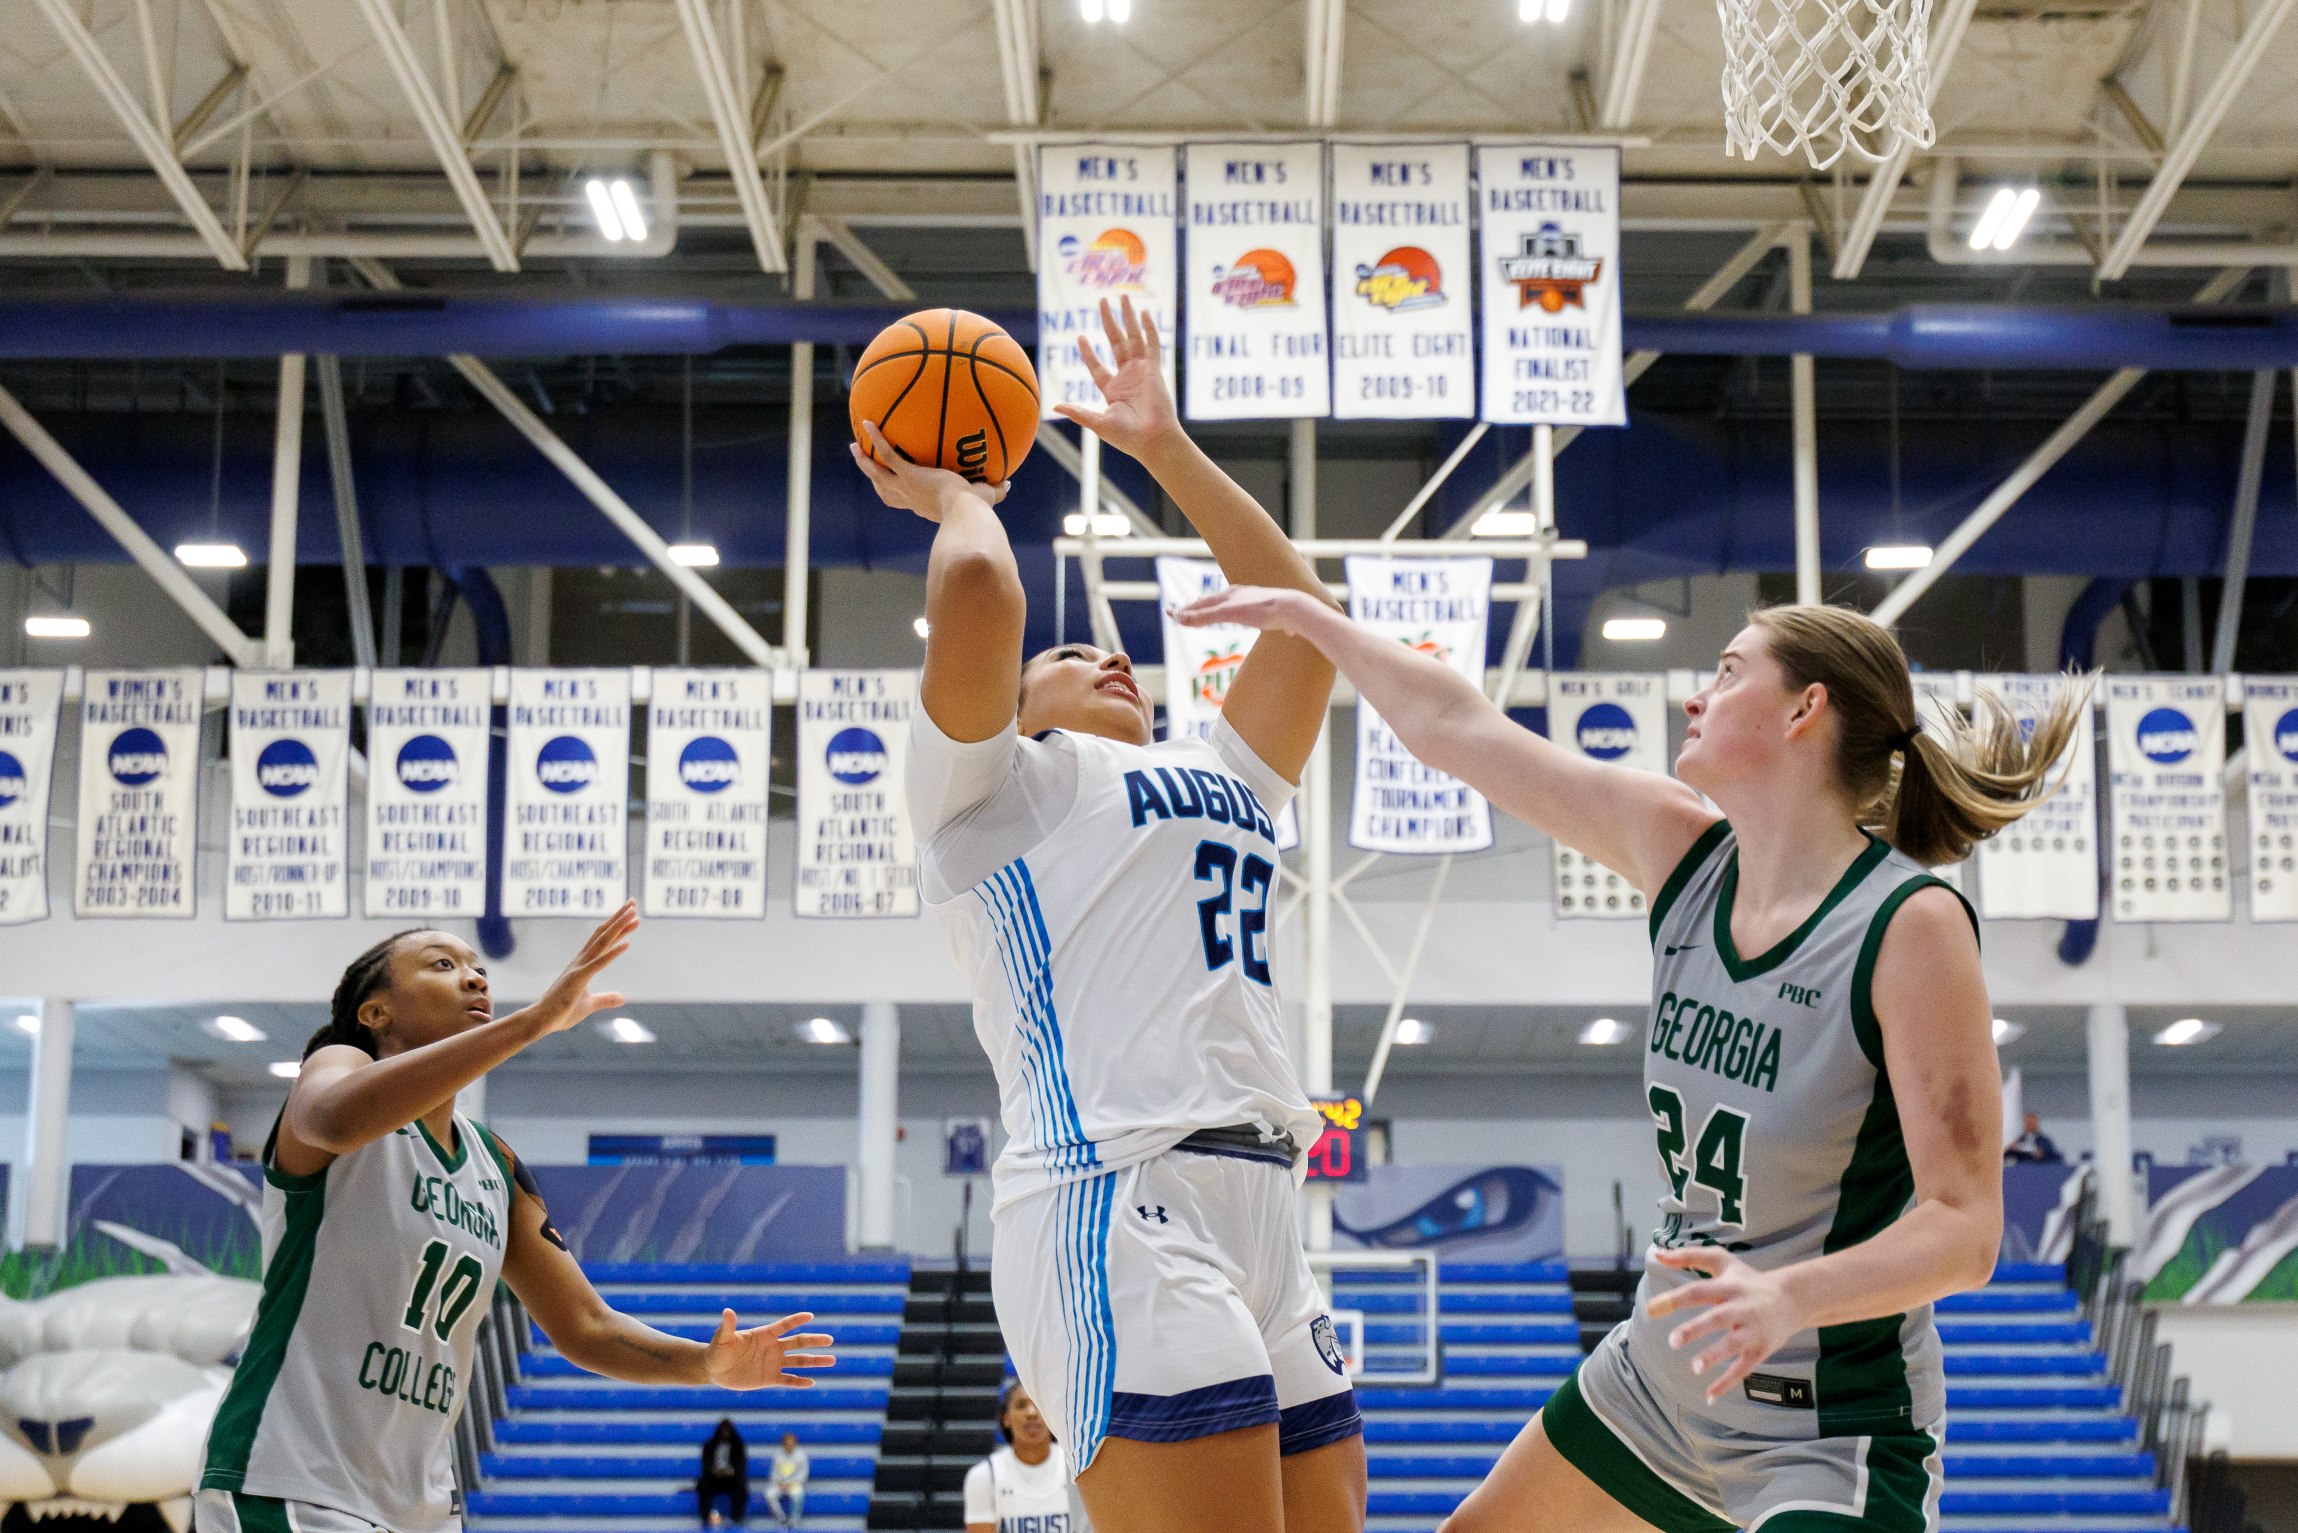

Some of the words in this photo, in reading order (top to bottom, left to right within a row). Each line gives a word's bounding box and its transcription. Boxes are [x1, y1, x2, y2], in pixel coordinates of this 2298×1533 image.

[1079, 157, 1138, 180] MEN'S
[1225, 161, 1287, 184] MEN'S
[1370, 162, 1433, 186] MEN'S
[1521, 158, 1577, 180] MEN'S
[1044, 193, 1174, 217] BASKETBALL
[1491, 190, 1606, 212] BASKETBALL
[1194, 202, 1317, 225] BASKETBALL
[1340, 203, 1463, 226] BASKETBALL
[1194, 335, 1252, 358] FINAL
[1271, 333, 1325, 357] FOUR
[1339, 334, 1395, 358] ELITE
[1412, 333, 1466, 357] EIGHT
[1508, 328, 1596, 350] NATIONAL
[1515, 360, 1590, 382] FINALIST
[1362, 376, 1447, 400] 2009-10
[1514, 391, 1595, 413] 2021-22
[1392, 572, 1448, 595] MEN'S
[1362, 599, 1480, 621] BASKETBALL
[109, 680, 182, 700] WOMEN'S
[265, 682, 318, 701] MEN'S
[404, 679, 458, 699] MEN'S
[544, 680, 597, 700] MEN'S
[686, 681, 738, 701] MEN'S
[832, 677, 885, 697] MEN'S
[89, 703, 194, 723] BASKETBALL
[239, 708, 341, 729] BASKETBALL
[376, 706, 482, 727] BASKETBALL
[516, 706, 623, 727] BASKETBALL
[657, 708, 763, 730] BASKETBALL
[805, 701, 911, 721] BASKETBALL
[1580, 727, 1638, 751] NCAA
[2140, 732, 2197, 753] NCAA
[112, 752, 169, 776] NCAA
[401, 760, 459, 783] NCAA
[541, 760, 599, 784] NCAA
[683, 760, 741, 784] NCAA
[830, 752, 888, 776] NCAA
[261, 764, 319, 788] NCAA
[111, 792, 164, 812] SOUTH
[832, 793, 885, 813] SOUTH
[236, 807, 338, 828] SOUTHEAST
[377, 804, 477, 824] SOUTHEAST
[517, 804, 618, 825] SOUTHEAST
[97, 816, 177, 835] ATLANTIC
[818, 817, 897, 837] ATLANTIC
[1369, 815, 1476, 838] CHAMPIONS
[94, 840, 173, 859] REGIONAL
[243, 837, 330, 856] REGIONAL
[384, 832, 468, 852] REGIONAL
[523, 832, 609, 852] REGIONAL
[664, 831, 748, 852] REGIONAL
[816, 844, 897, 862] REGIONAL
[88, 863, 182, 883] CHAMPIONS
[1193, 839, 1274, 987] 22
[1778, 982, 1822, 1009] PBC
[1651, 991, 1782, 1093] GEORGIA
[1647, 1080, 1751, 1231] 24
[411, 1169, 500, 1251] GEORGIA
[400, 1236, 485, 1346] 10
[1790, 1387, 1803, 1400] M
